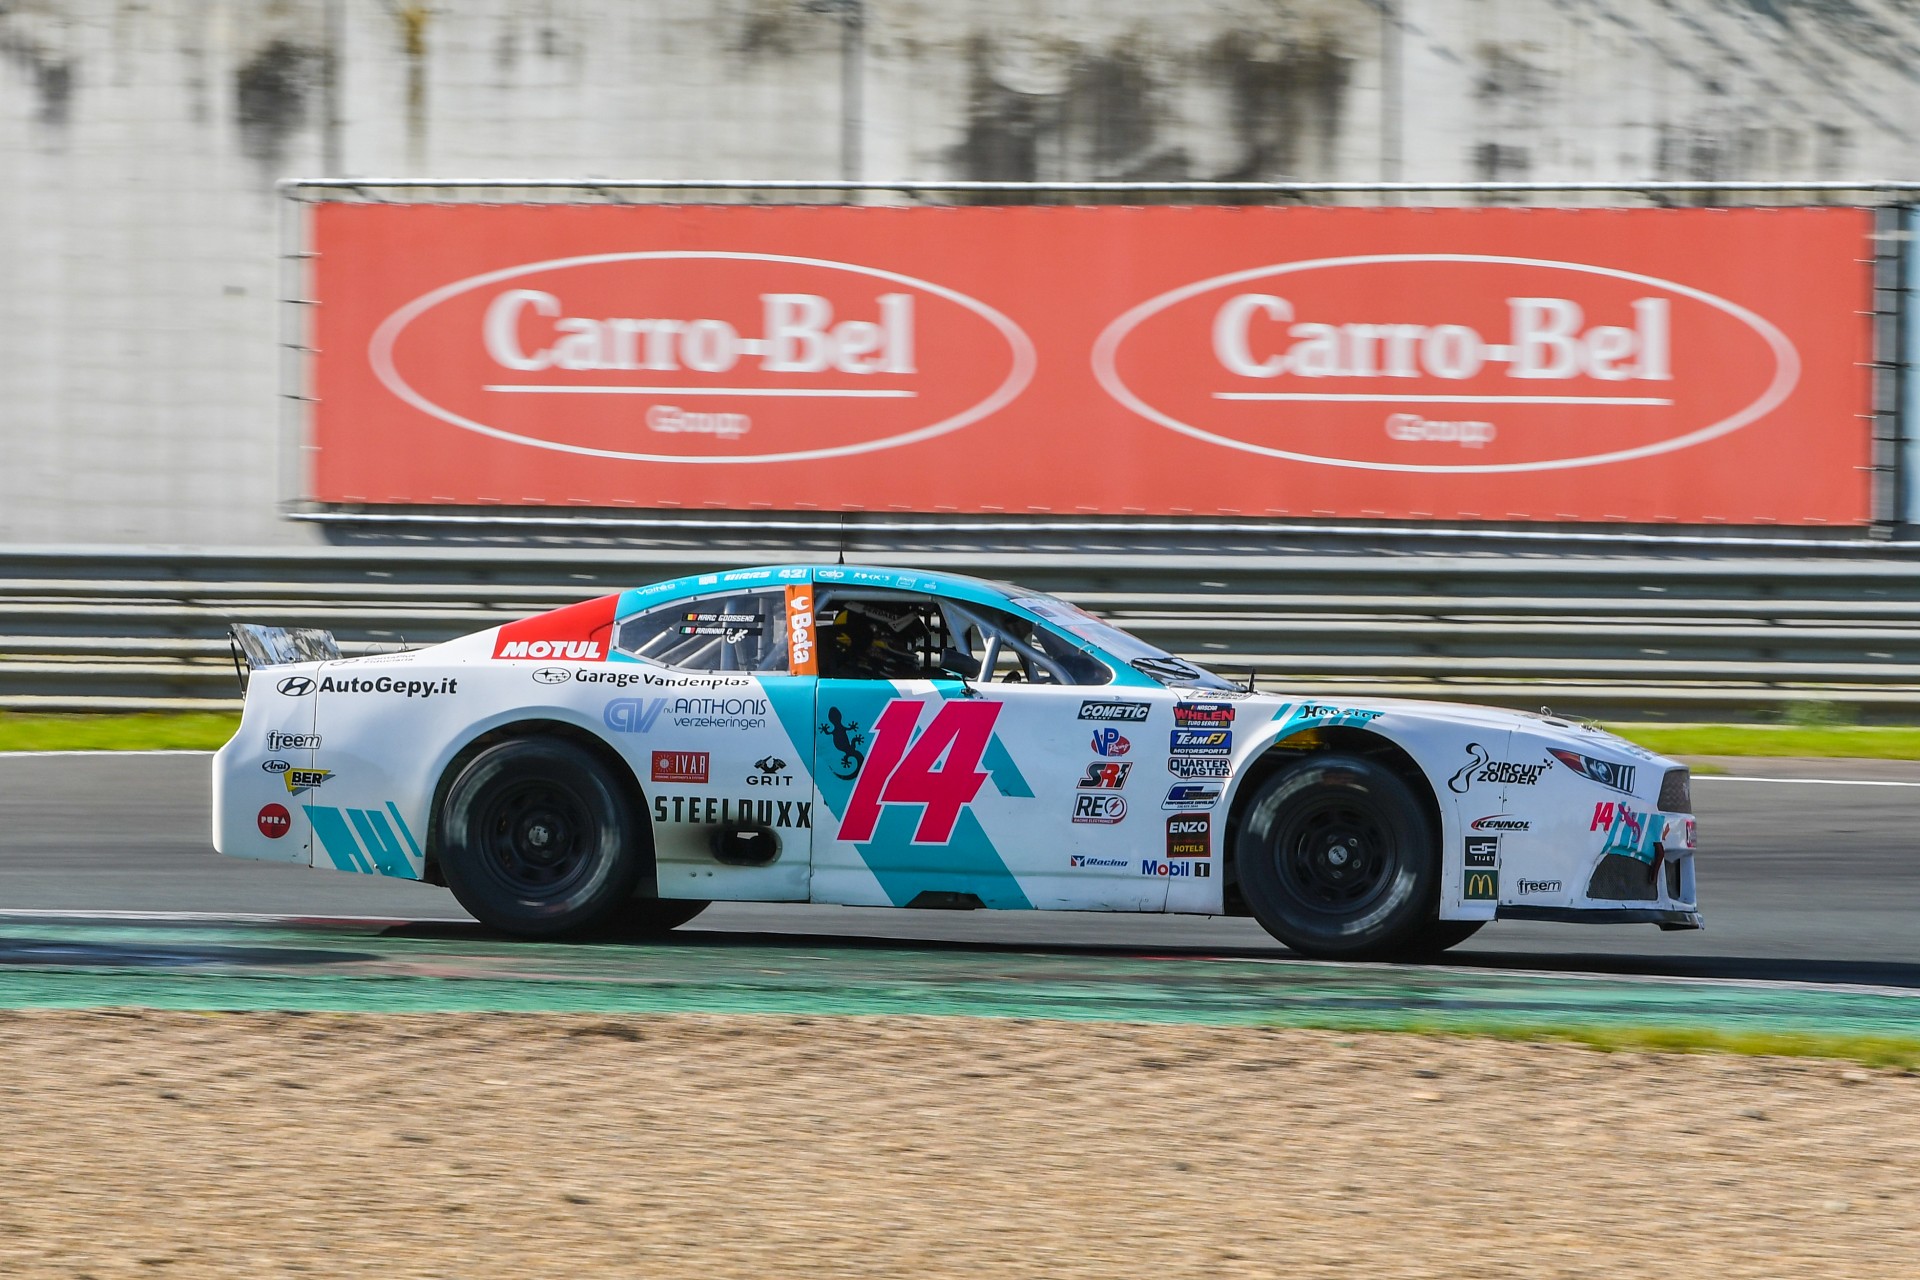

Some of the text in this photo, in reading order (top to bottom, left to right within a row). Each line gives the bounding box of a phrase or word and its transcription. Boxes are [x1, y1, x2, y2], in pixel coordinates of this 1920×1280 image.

[482, 288, 917, 374] Carro-Bel
[1211, 292, 1673, 381] Carro-Bel
[646, 404, 751, 439] Group
[1386, 412, 1496, 448] Group
[791, 612, 813, 665] Beta
[500, 640, 601, 659] MOTUL
[319, 676, 458, 698] AutoGepy.it
[575, 669, 750, 690] Garage Vandenplas
[675, 698, 767, 716] ANTHONIS
[1081, 704, 1149, 719] COMETIC
[1174, 708, 1235, 721] WHELEN
[674, 716, 766, 731] verzekeringen
[269, 732, 320, 749] freem
[1093, 727, 1119, 757] VP
[266, 761, 287, 770] Arai
[676, 755, 706, 774] IVAR
[1171, 759, 1228, 771] QUARTER
[1180, 767, 1230, 777] MASTER
[1486, 761, 1546, 776] CIRCUIT
[292, 772, 322, 784] BER
[746, 775, 793, 786] GRIT
[837, 700, 1004, 846] 14
[1477, 771, 1537, 785] ZOLDER
[261, 816, 286, 824] PURA
[654, 796, 812, 829] STEELDUXX
[1590, 802, 1614, 831] 14
[1169, 822, 1208, 833] ENZO
[1476, 821, 1530, 829] KENNOL
[1086, 858, 1128, 867] iRacing
[1142, 860, 1189, 876] Mobil
[1519, 880, 1561, 893] freem
